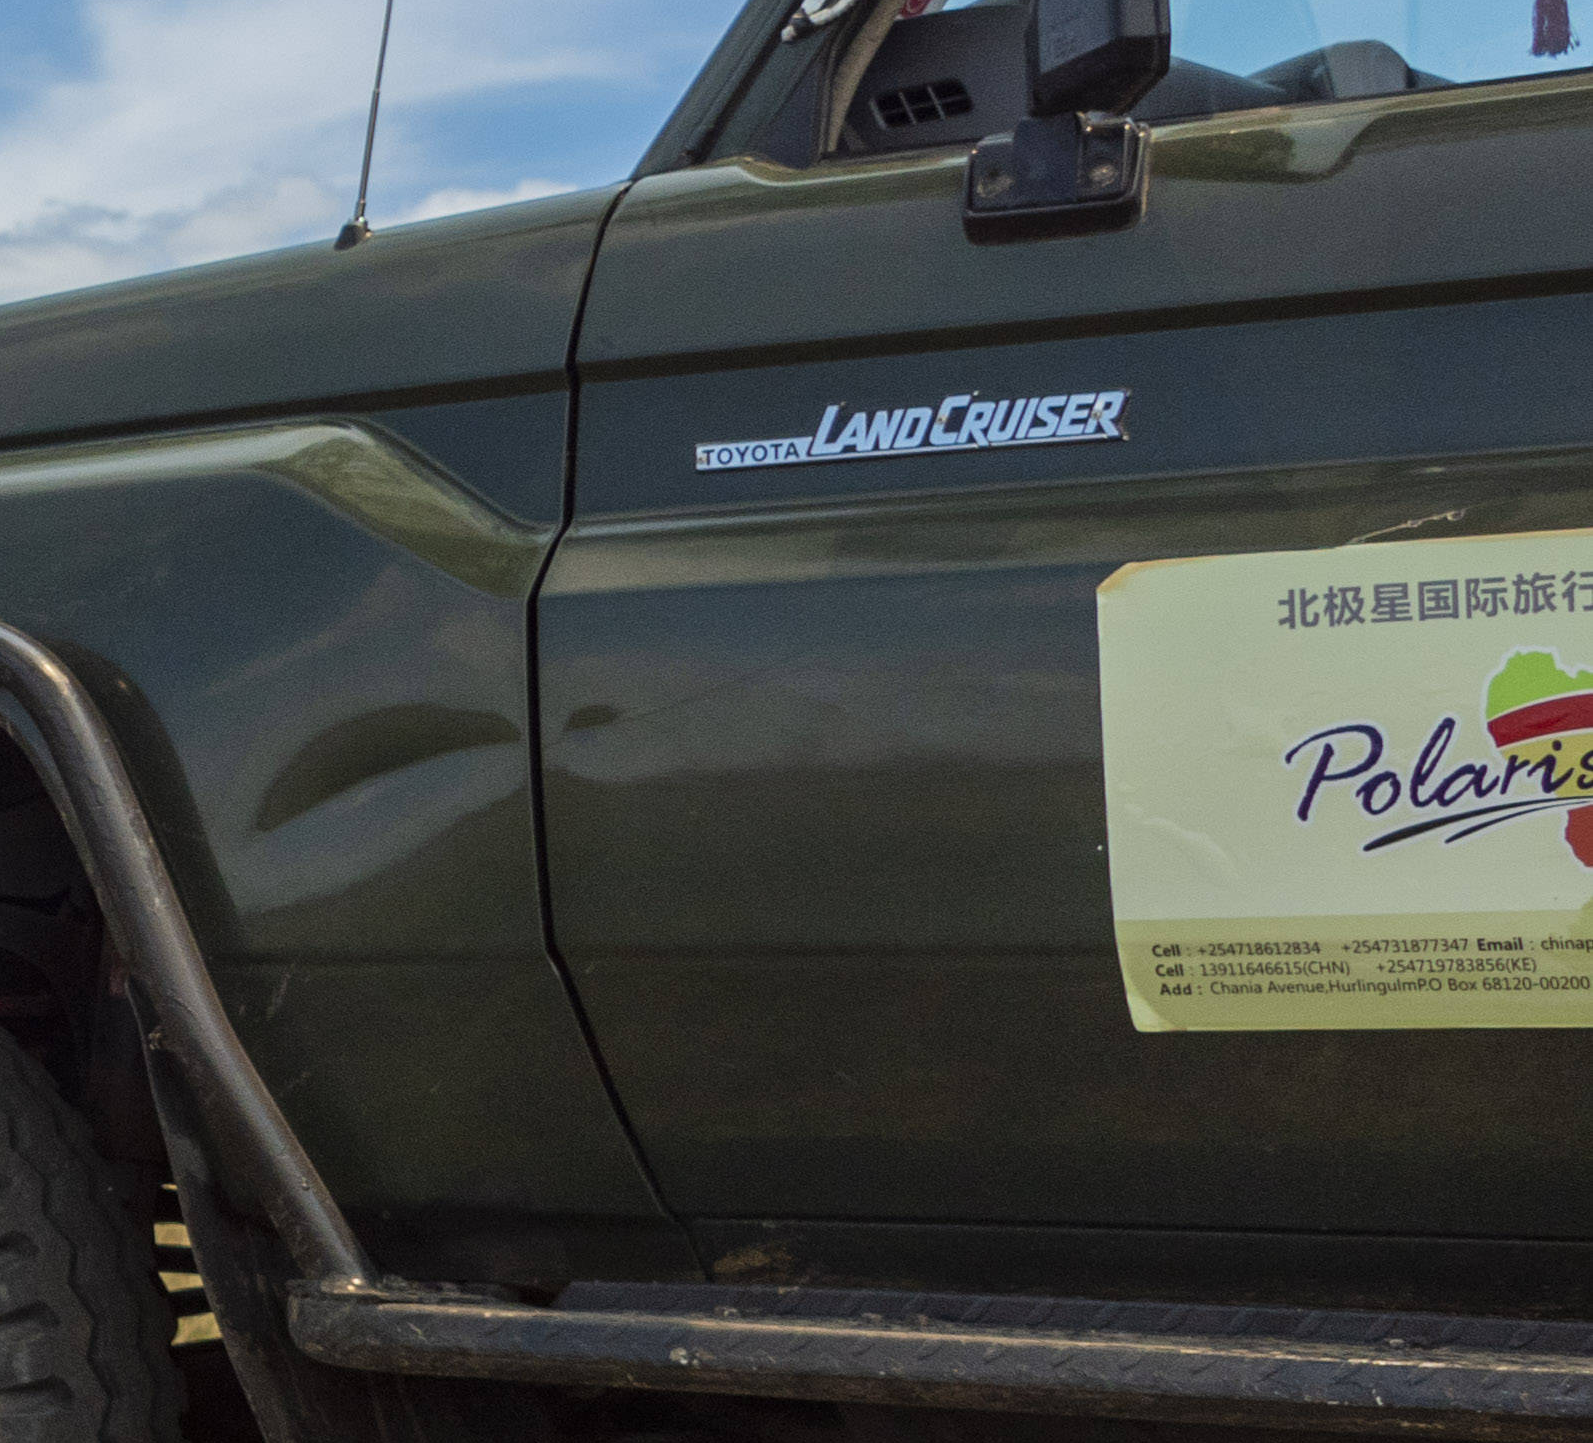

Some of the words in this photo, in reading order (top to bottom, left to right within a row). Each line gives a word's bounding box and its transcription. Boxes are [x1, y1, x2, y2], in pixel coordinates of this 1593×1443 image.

[702, 442, 800, 466] TOYOTA
[1278, 570, 1593, 630] 北极星国际旅行
[1285, 717, 1593, 822] Polaris
[1198, 941, 1321, 956] +254718612834
[1343, 938, 1469, 955] +254731877347
[1200, 961, 1351, 977] 13911646615(CHN)
[1377, 957, 1537, 974] +254719783856(KE)
[1210, 981, 1262, 995] Chania
[1448, 978, 1477, 992] Box
[1482, 975, 1590, 991] 68120-00200
